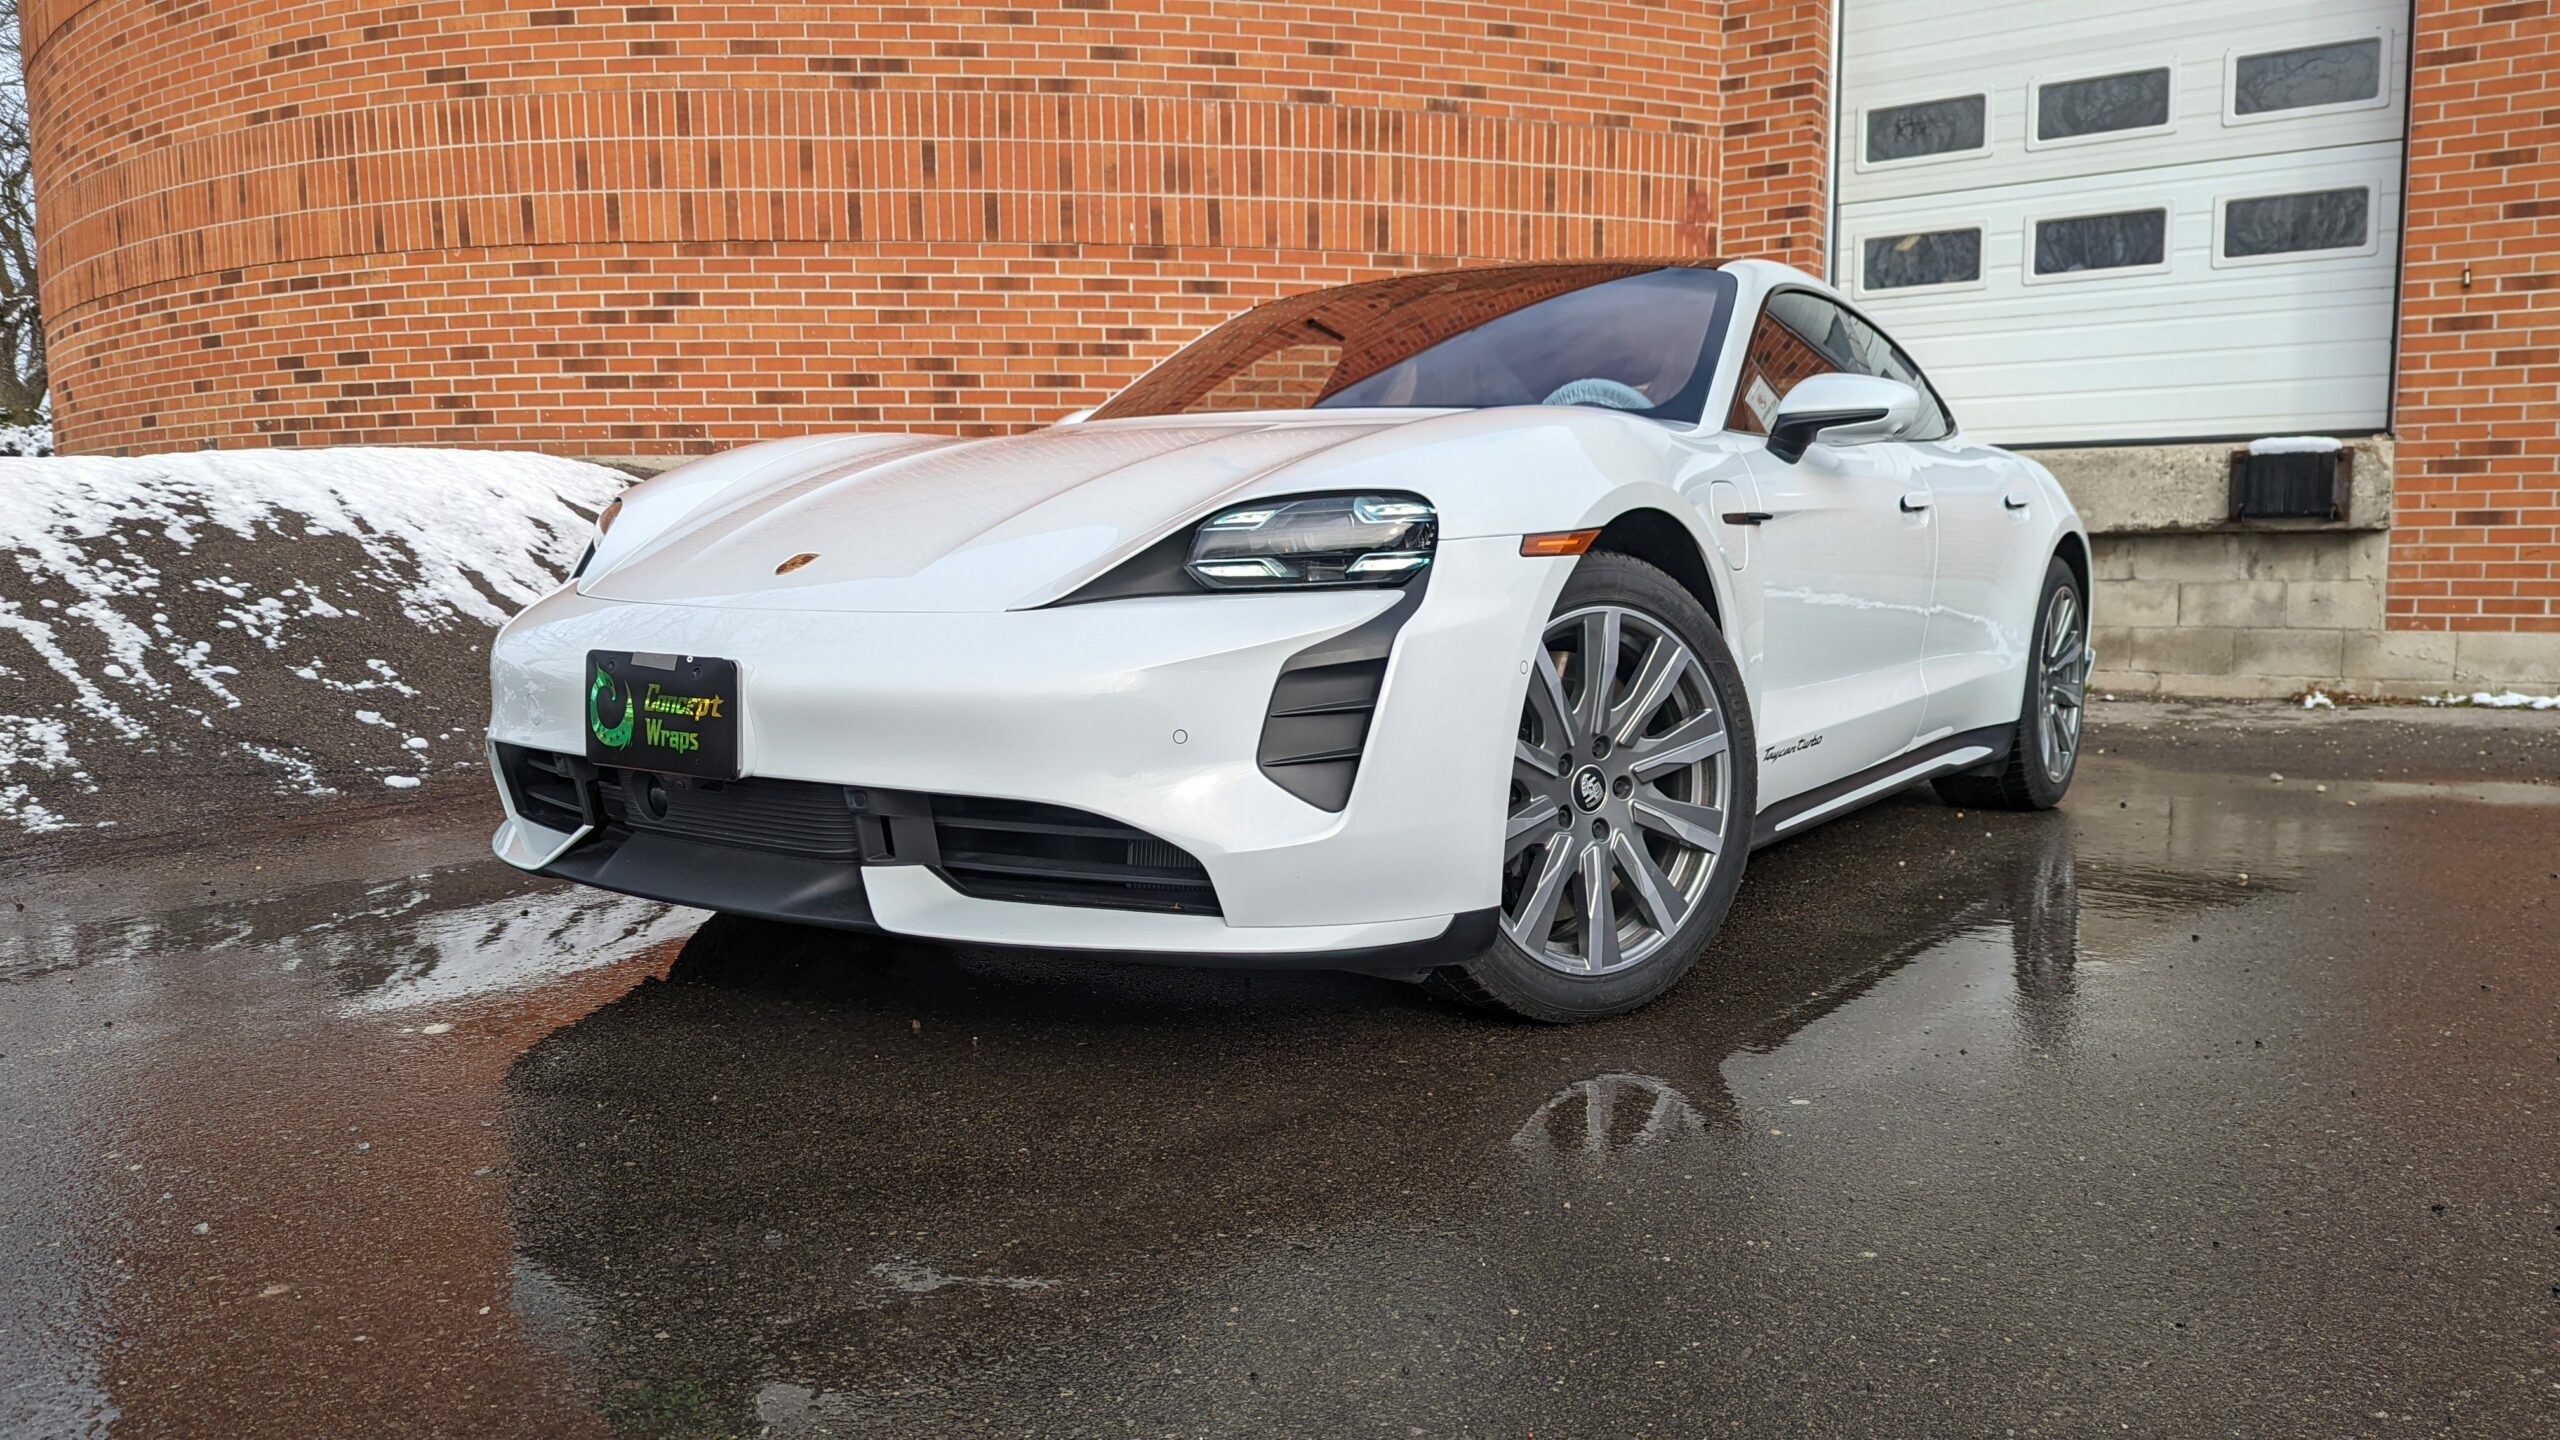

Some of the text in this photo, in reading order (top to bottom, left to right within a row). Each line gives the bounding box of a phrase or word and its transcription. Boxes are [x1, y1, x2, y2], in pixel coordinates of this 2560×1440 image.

[644, 683, 724, 721] Concept
[645, 718, 699, 753] Wraps
[1762, 746, 1796, 764] Taycan
